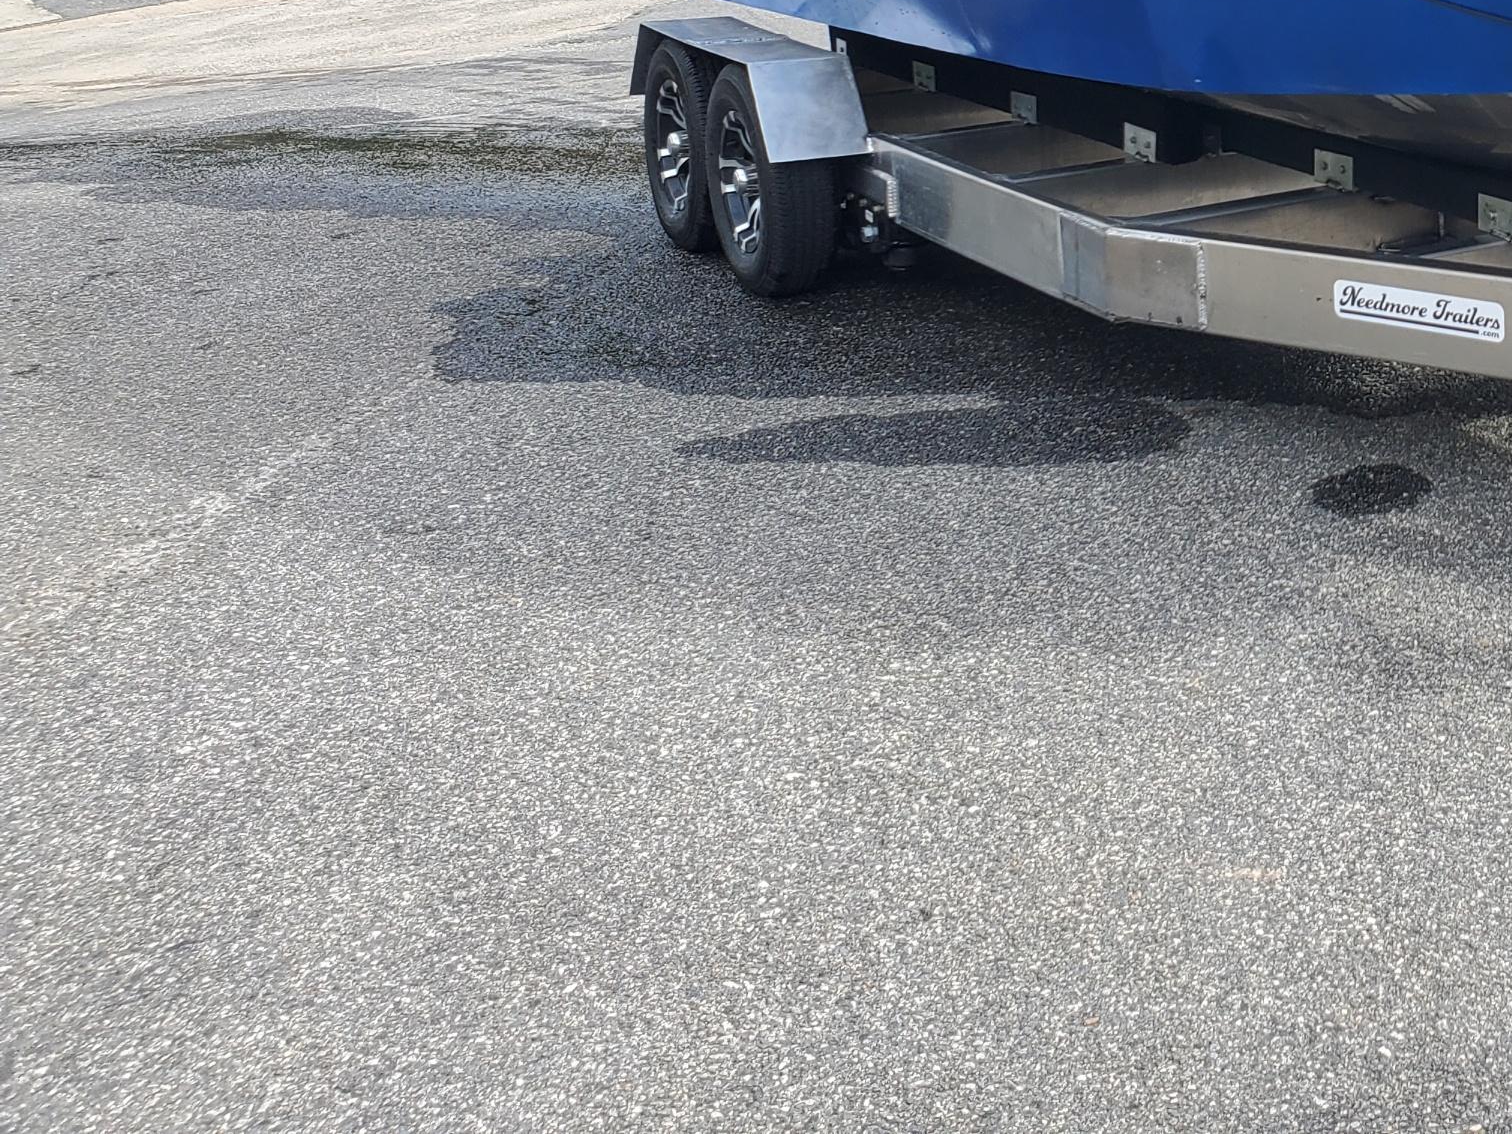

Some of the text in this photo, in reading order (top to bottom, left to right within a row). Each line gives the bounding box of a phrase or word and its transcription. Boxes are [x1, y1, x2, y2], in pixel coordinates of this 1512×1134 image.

[1339, 285, 1500, 330] Needmore Trailers
[1480, 330, 1500, 339] .com
